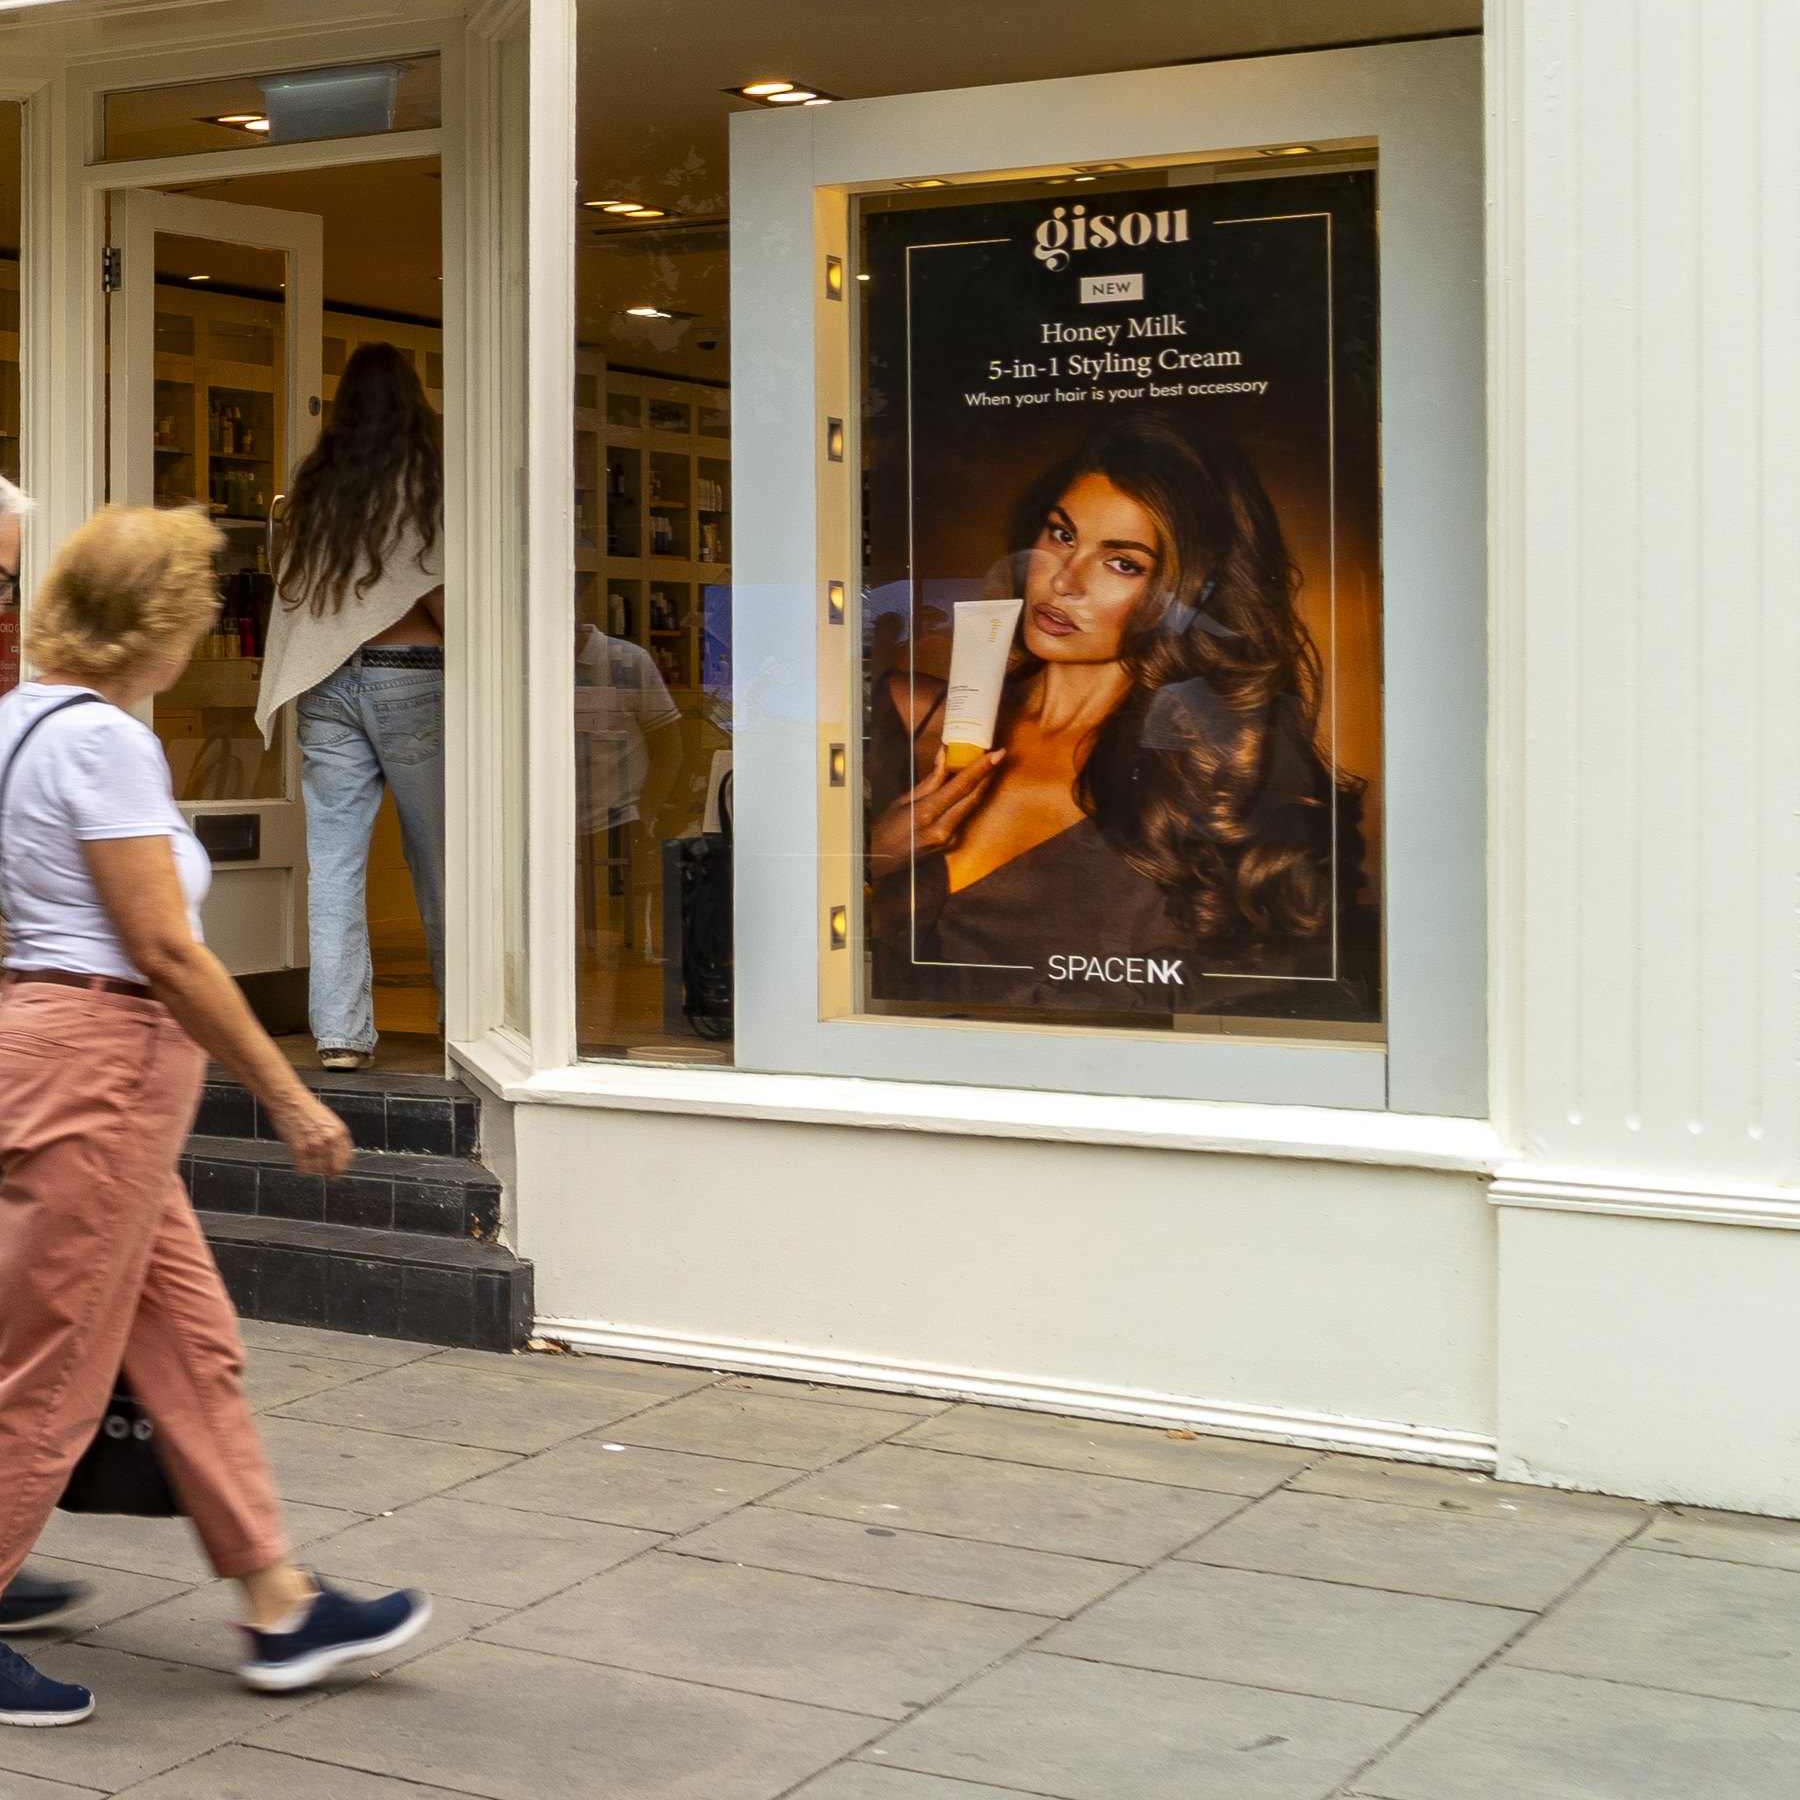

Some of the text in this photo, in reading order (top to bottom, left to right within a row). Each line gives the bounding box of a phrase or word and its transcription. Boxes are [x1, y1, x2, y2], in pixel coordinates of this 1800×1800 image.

[1034, 205, 1190, 272] gisou
[1092, 281, 1131, 296] NEW
[1041, 314, 1187, 346] Honey Milk
[988, 349, 1242, 380] 5-in-1 Styling Cream
[964, 379, 1269, 408] When your hair is your best accessory
